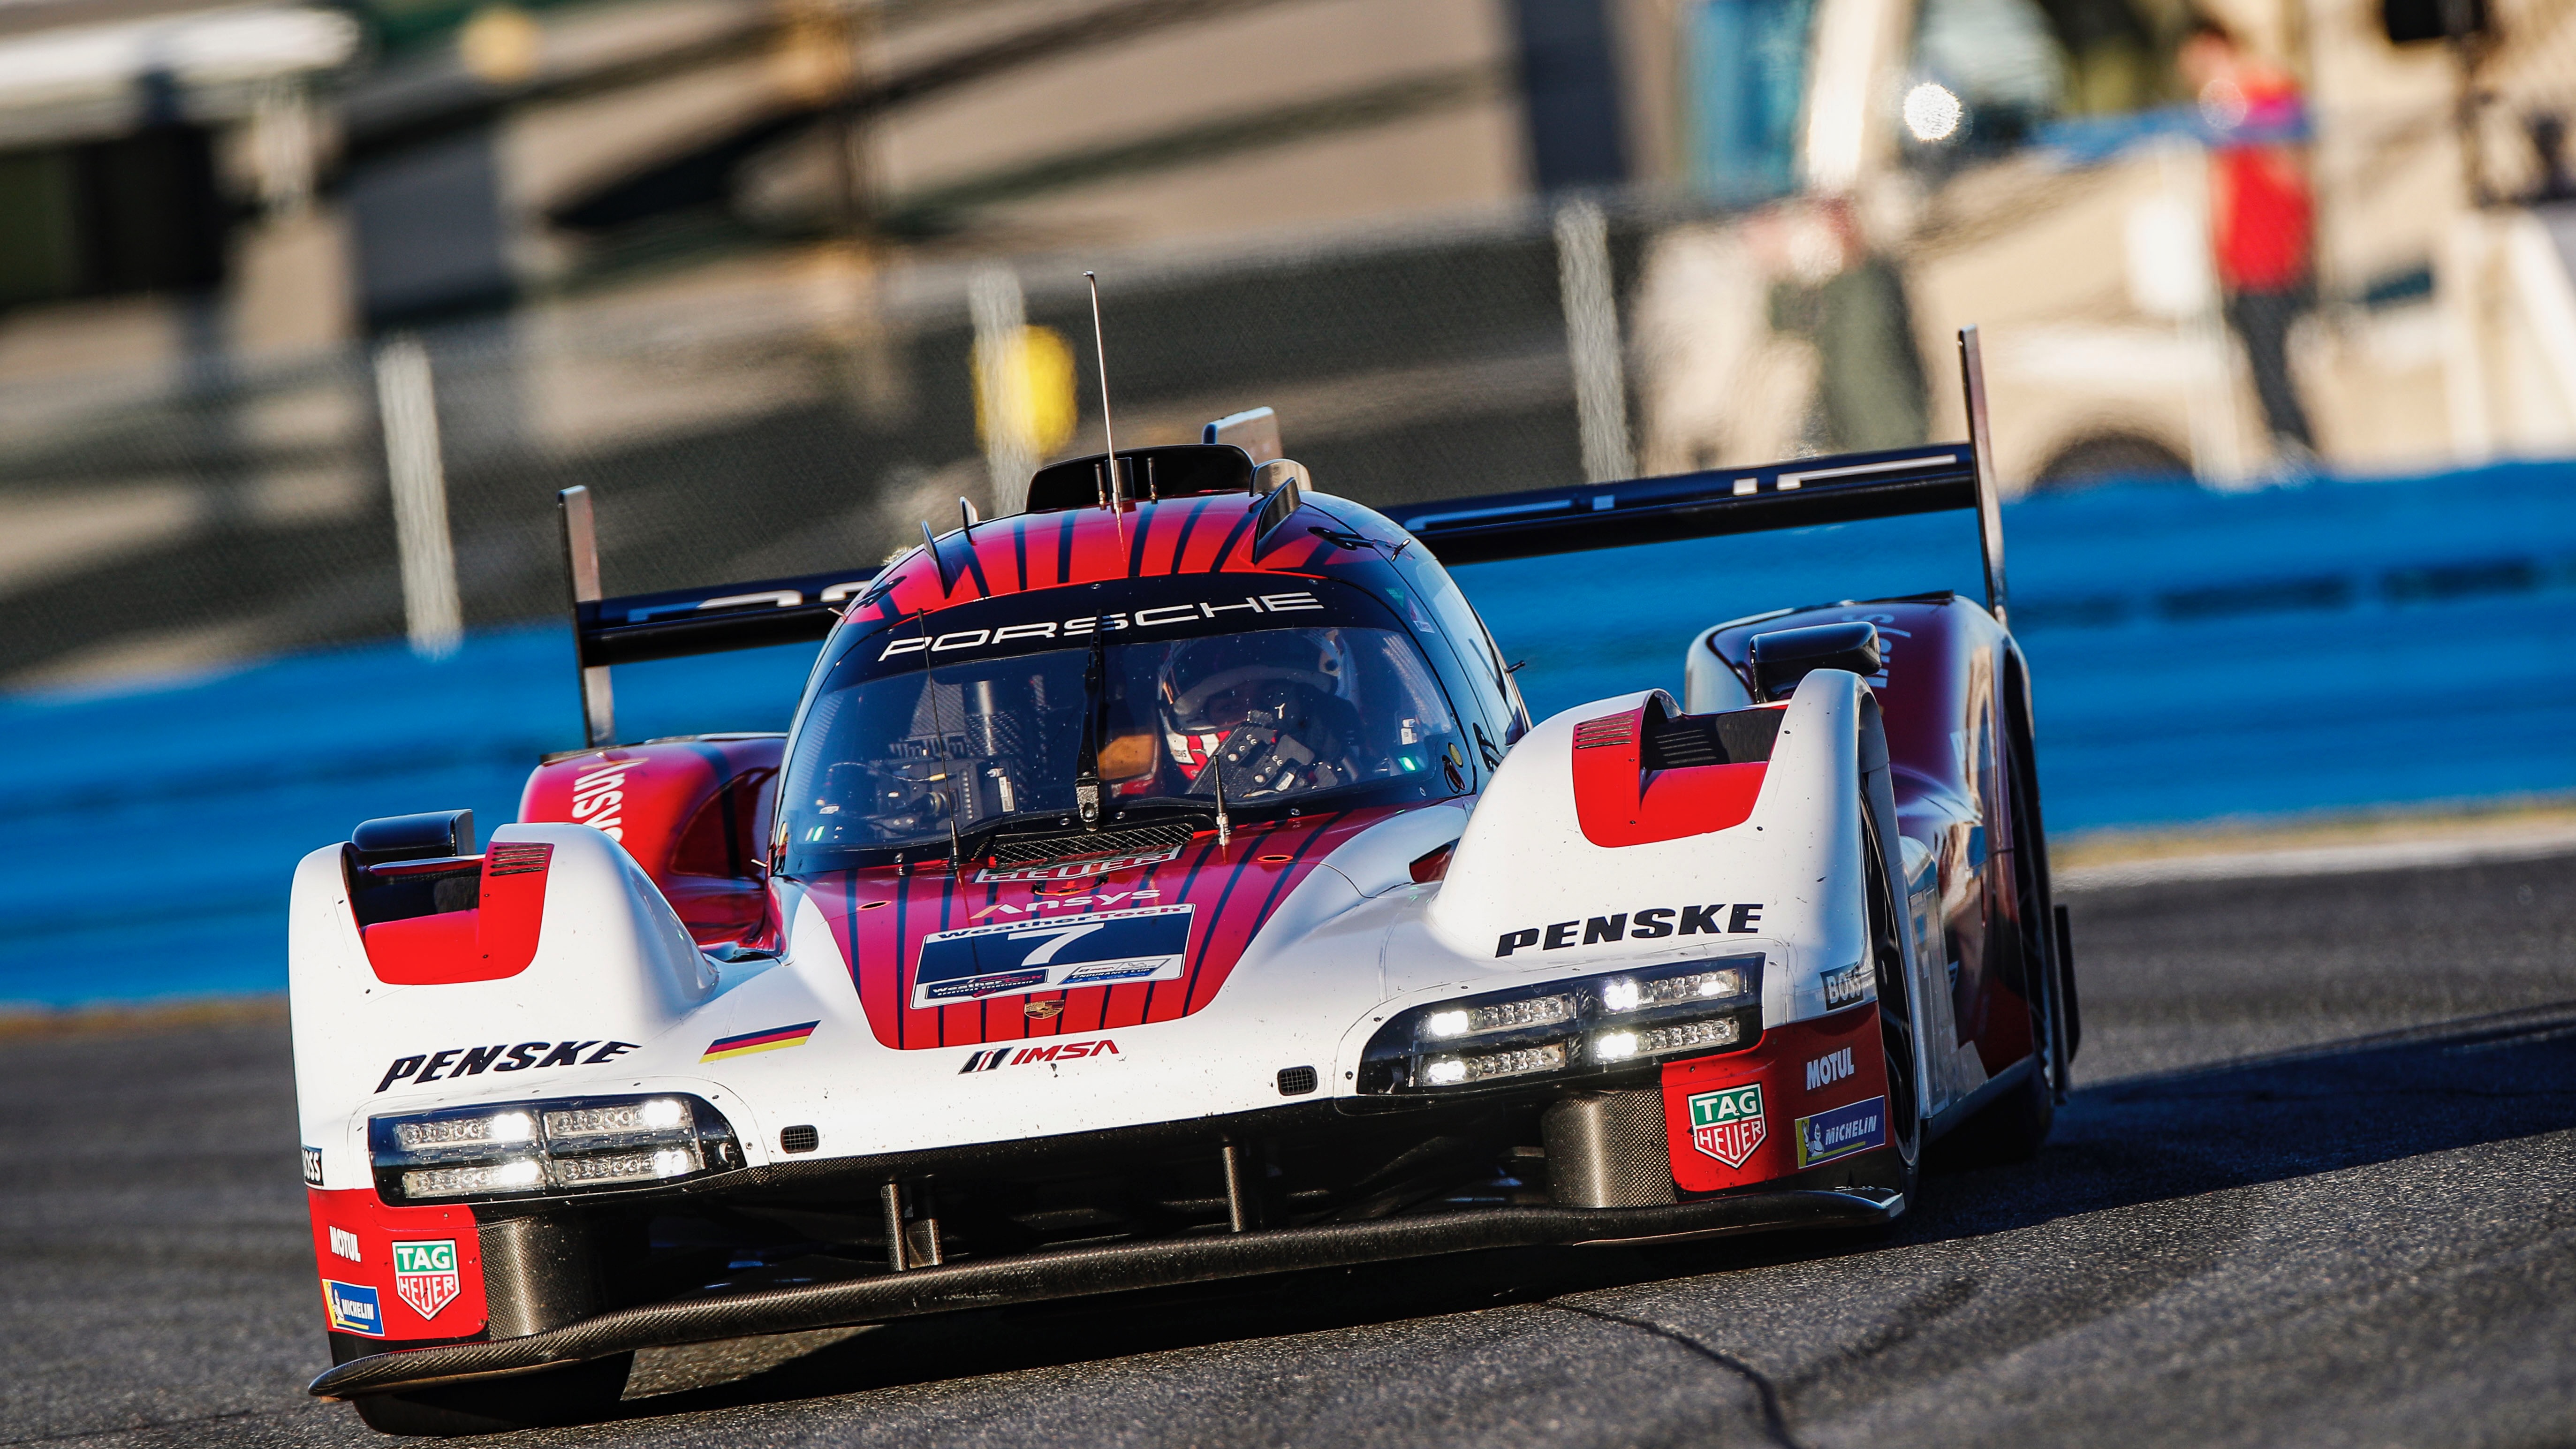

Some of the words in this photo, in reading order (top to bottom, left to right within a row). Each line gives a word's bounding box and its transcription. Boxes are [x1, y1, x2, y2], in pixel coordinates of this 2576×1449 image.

[878, 592, 1325, 662] PORSCHE
[990, 855, 1165, 880] HEUER
[969, 889, 1160, 919] Ansys
[938, 906, 1182, 940] WeatherTech
[1495, 903, 1764, 958] PENSKE
[1008, 923, 1105, 966] 7
[373, 1040, 643, 1094] PENSKE
[1010, 1039, 1120, 1066] IMSA
[1806, 1047, 1855, 1091] MOTUL
[1696, 1091, 1757, 1121] TAG
[1699, 1121, 1762, 1160] HEUER
[1825, 1115, 1877, 1146] MICHELIN
[302, 1149, 321, 1182] OSS
[329, 1225, 361, 1263] MOTUL
[397, 1246, 451, 1270] TAG
[341, 1298, 374, 1320] MICHELIN
[399, 1275, 454, 1313] HEUER
